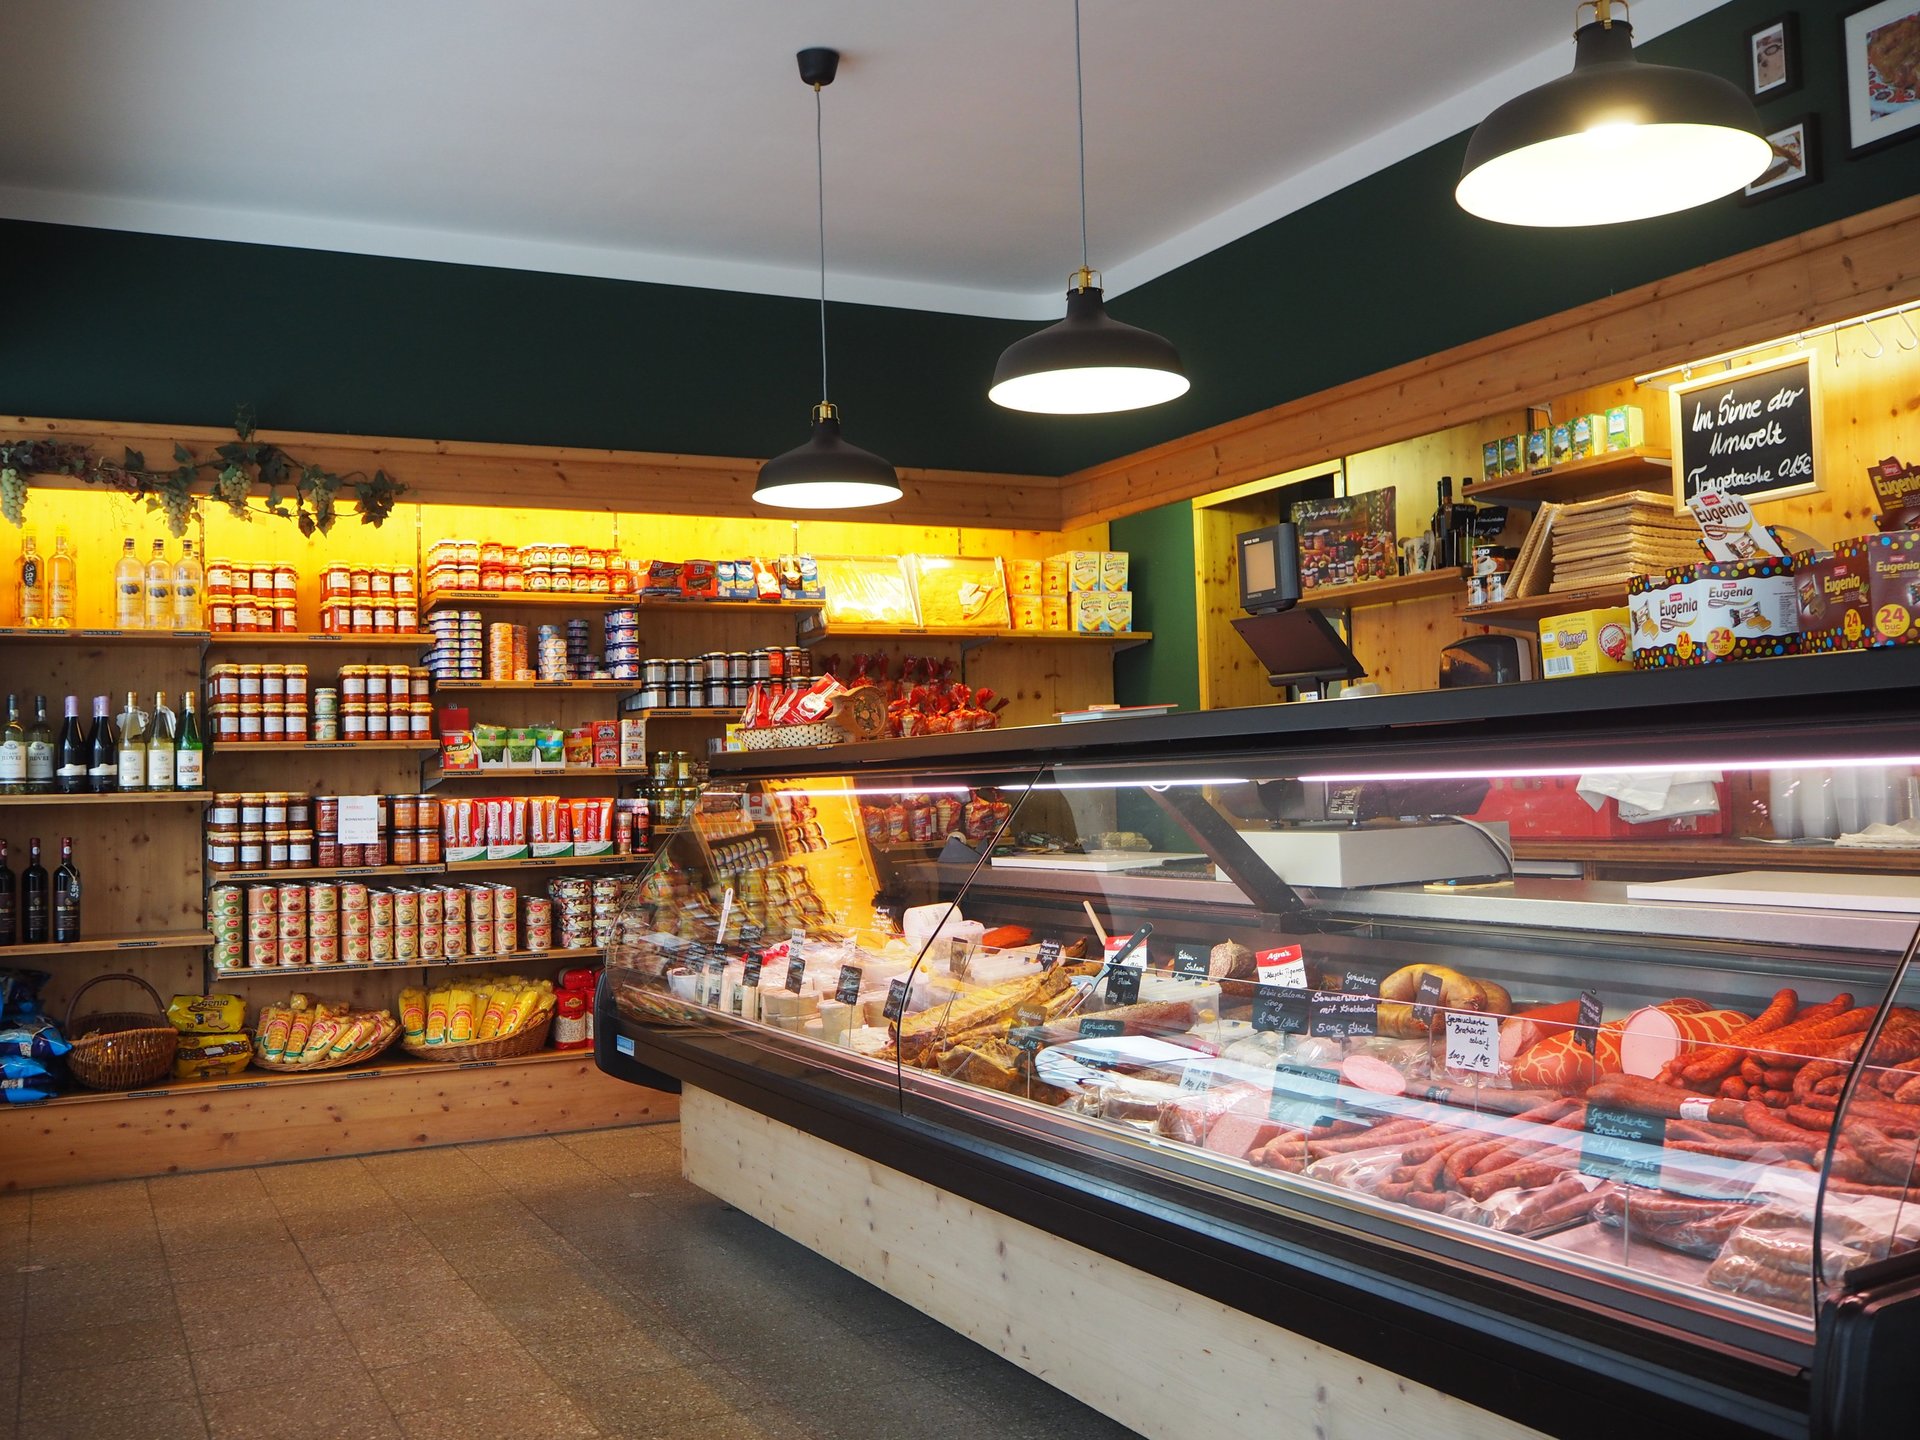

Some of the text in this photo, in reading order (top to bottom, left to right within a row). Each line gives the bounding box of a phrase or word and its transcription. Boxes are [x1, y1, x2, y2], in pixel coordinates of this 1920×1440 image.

[1692, 387, 1804, 432] Im Sinne der
[1709, 421, 1786, 456] Umwelt
[1692, 501, 1748, 524] Eugenia
[1876, 560, 1920, 573] Eugenia
[1824, 573, 1860, 595] Eugenia
[1709, 586, 1753, 600] Eugenia
[1660, 598, 1698, 619] Eugenia
[1880, 608, 1905, 623] 24
[1847, 613, 1858, 628] 24
[1678, 634, 1690, 647] 24
[1711, 629, 1731, 643] 24
[1277, 988, 1306, 999] Salami
[1264, 999, 1283, 1012] 500g
[1320, 1004, 1337, 1014] mit
